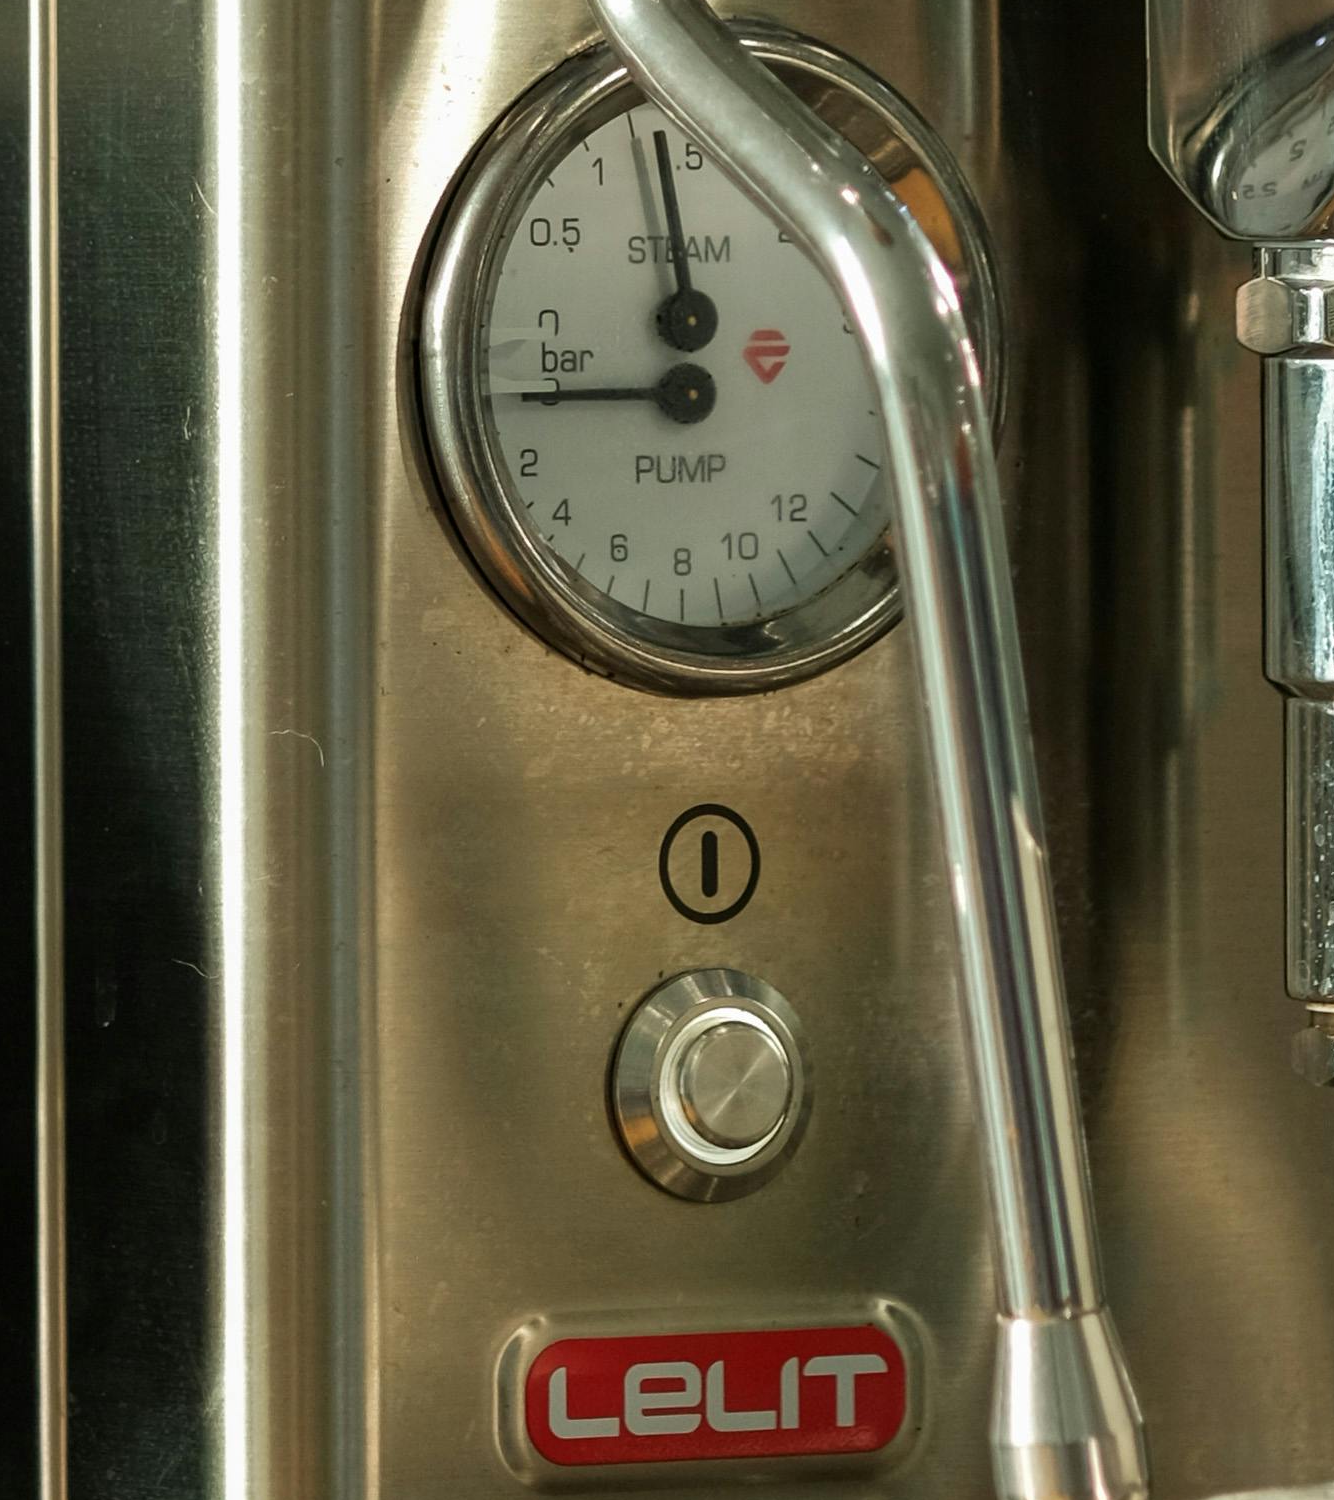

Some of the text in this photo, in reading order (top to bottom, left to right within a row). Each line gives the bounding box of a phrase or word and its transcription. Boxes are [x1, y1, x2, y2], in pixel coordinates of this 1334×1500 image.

[592, 157, 604, 186] 1
[530, 217, 581, 247] 0.5
[541, 341, 594, 373] bar
[520, 448, 539, 477] 2
[635, 454, 726, 483] PUMP
[552, 498, 572, 526] 4
[770, 494, 807, 522] 12
[610, 534, 629, 562] 6
[721, 532, 759, 560] 10
[673, 548, 692, 576] 8
